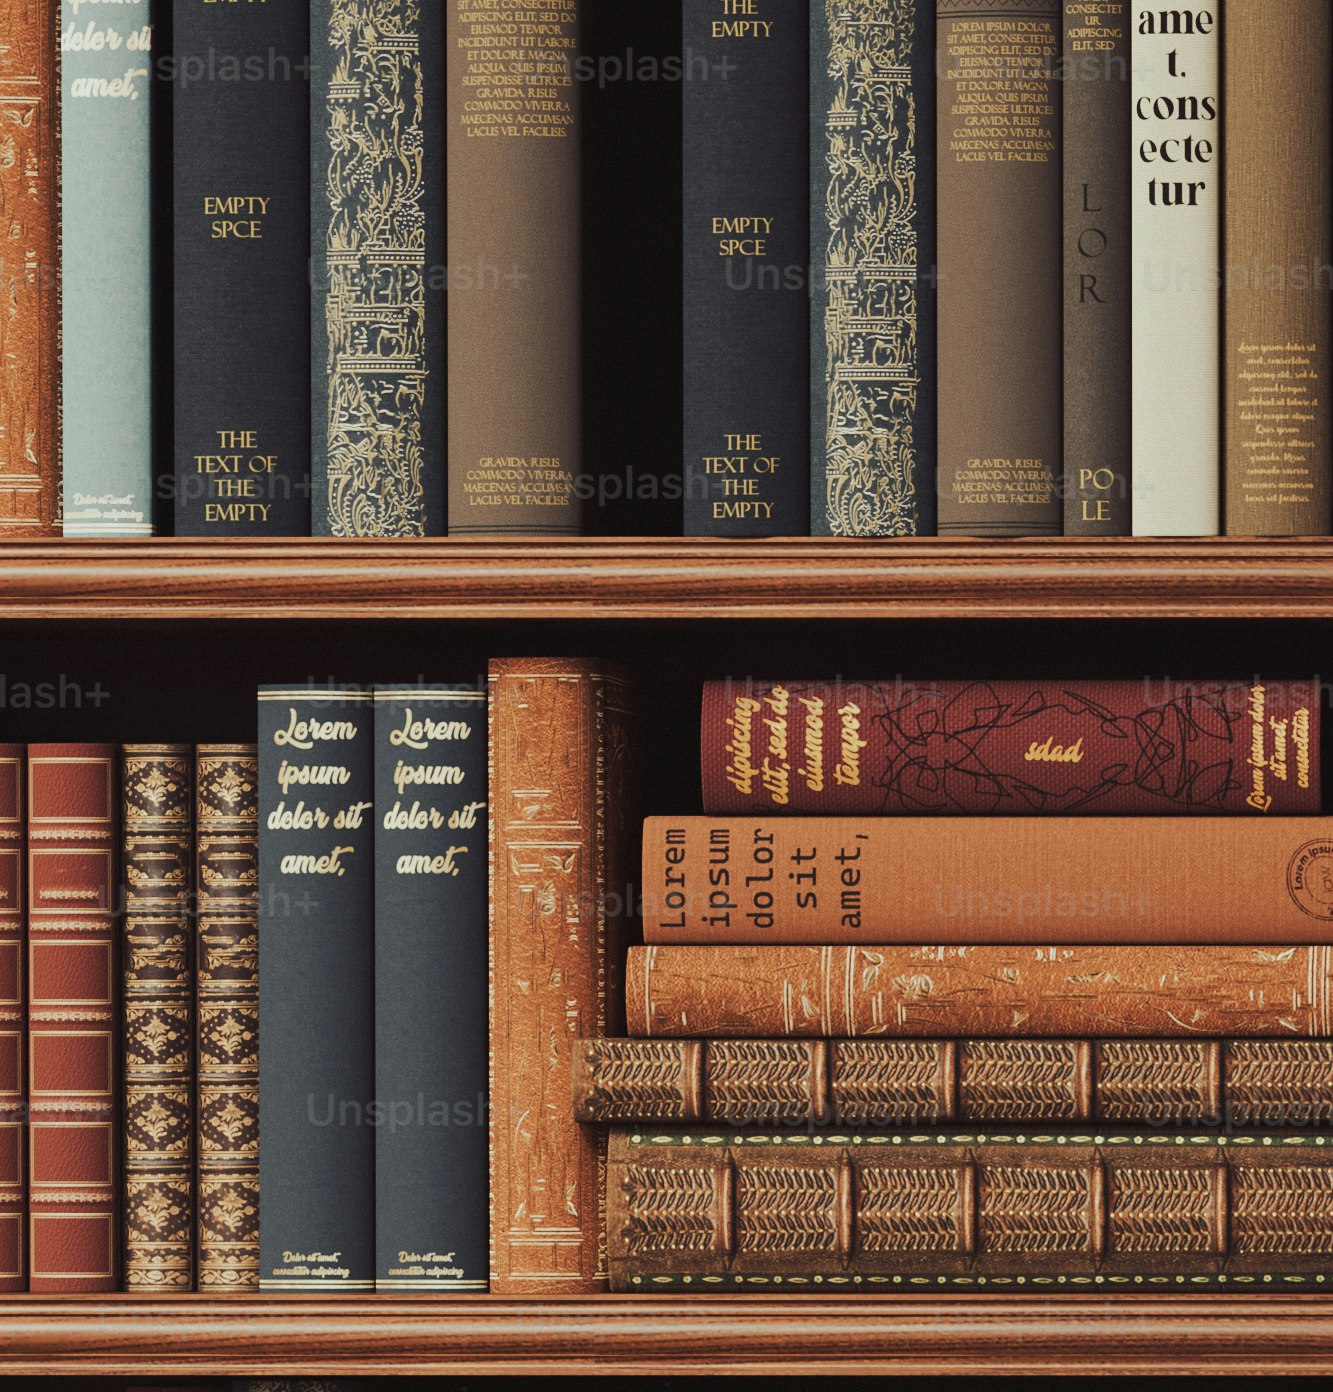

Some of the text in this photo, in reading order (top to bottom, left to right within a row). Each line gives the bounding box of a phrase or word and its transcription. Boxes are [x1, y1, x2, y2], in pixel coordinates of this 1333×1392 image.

[70, 69, 145, 99] amet,
[204, 197, 269, 215] EMPTY
[211, 221, 262, 238] SPCE
[217, 431, 257, 448] THE
[194, 455, 277, 473] TEXT OF
[1079, 468, 1114, 489] PO
[213, 479, 255, 497] THE
[205, 504, 268, 521] EMPTY
[1081, 500, 1110, 521] LE
[274, 708, 357, 749] Lorem
[798, 696, 824, 791] eiusmod
[834, 702, 867, 785] tempor
[725, 697, 765, 793] dipiscing
[762, 686, 791, 804] elit, sed do
[1024, 736, 1084, 763] sdad
[278, 760, 350, 794] ipsum
[267, 801, 372, 830] dolor sit
[280, 846, 354, 876] amet,
[659, 829, 691, 932] Lorem
[701, 829, 733, 932] ipsum
[743, 828, 775, 932] dolor
[789, 848, 817, 909] sit
[837, 834, 873, 932] amet,
